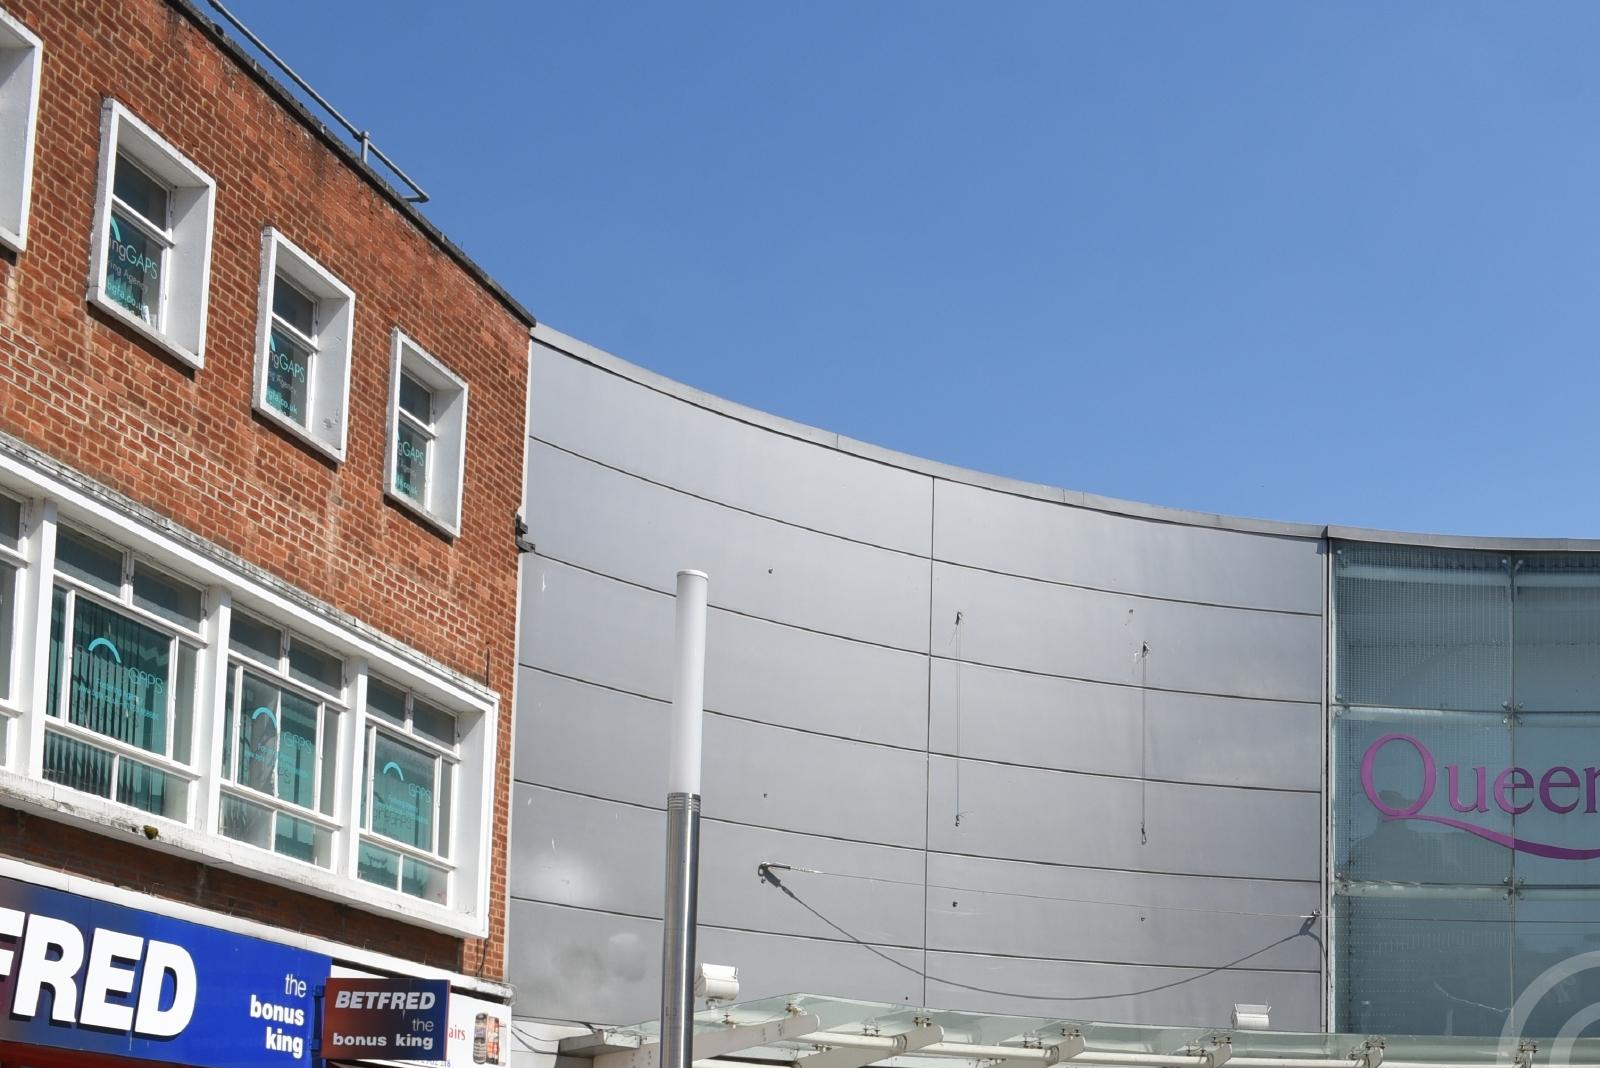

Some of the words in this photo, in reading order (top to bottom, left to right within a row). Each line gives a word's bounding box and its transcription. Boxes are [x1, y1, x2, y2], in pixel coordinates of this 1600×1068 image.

[285, 973, 307, 998] the
[250, 994, 304, 1027] bonus
[335, 991, 435, 1011] BETFRED
[412, 1018, 434, 1033] the
[265, 1026, 303, 1059] king
[333, 1032, 387, 1047] bonus
[395, 1033, 433, 1051] king
